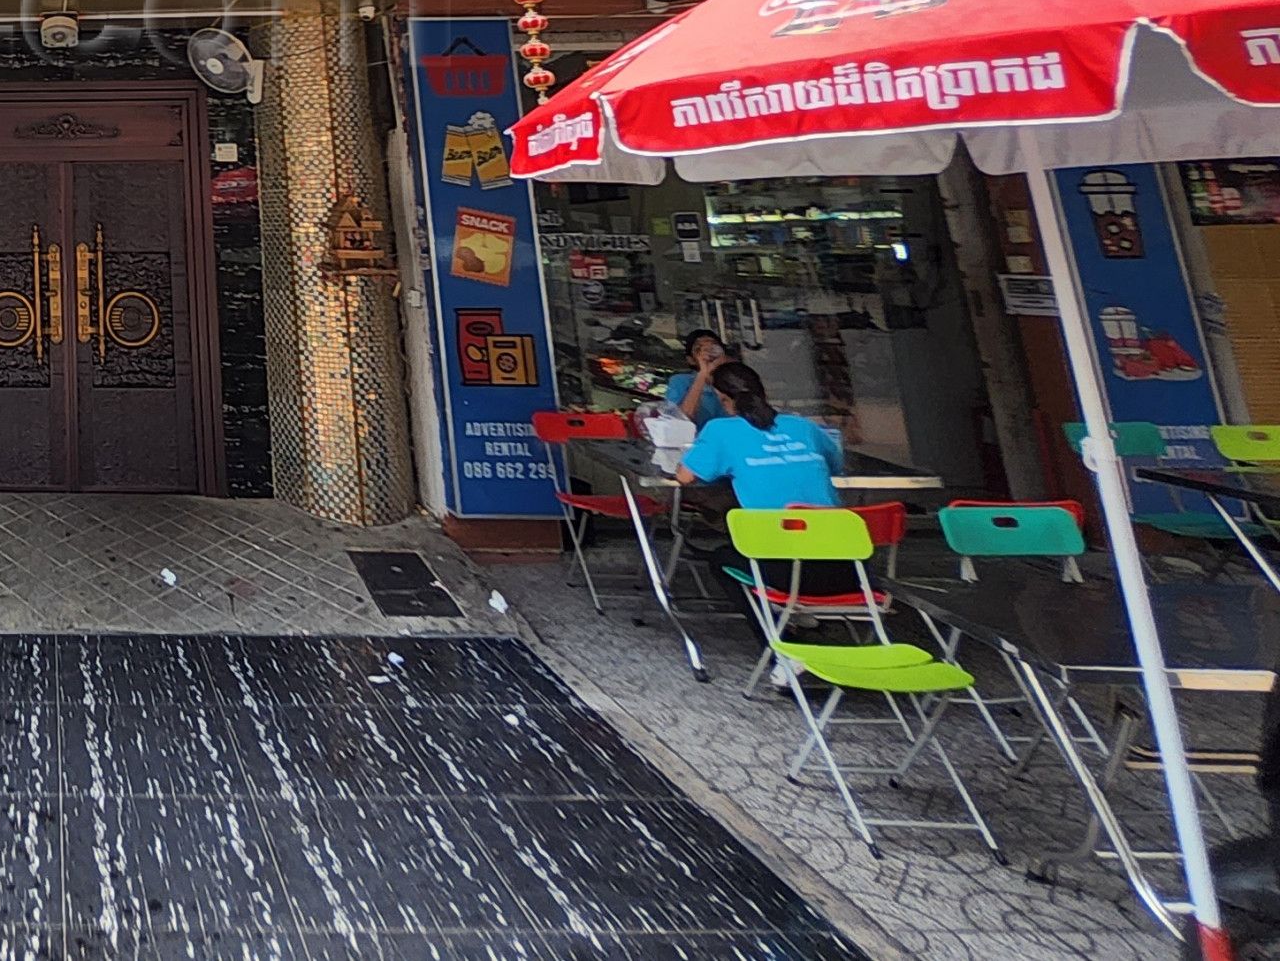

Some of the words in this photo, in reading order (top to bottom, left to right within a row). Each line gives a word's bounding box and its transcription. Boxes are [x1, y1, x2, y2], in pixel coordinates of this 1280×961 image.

[460, 213, 510, 233] SNACK
[484, 441, 533, 457] RENTAL
[463, 461, 493, 479] 086
[495, 461, 525, 479] 662
